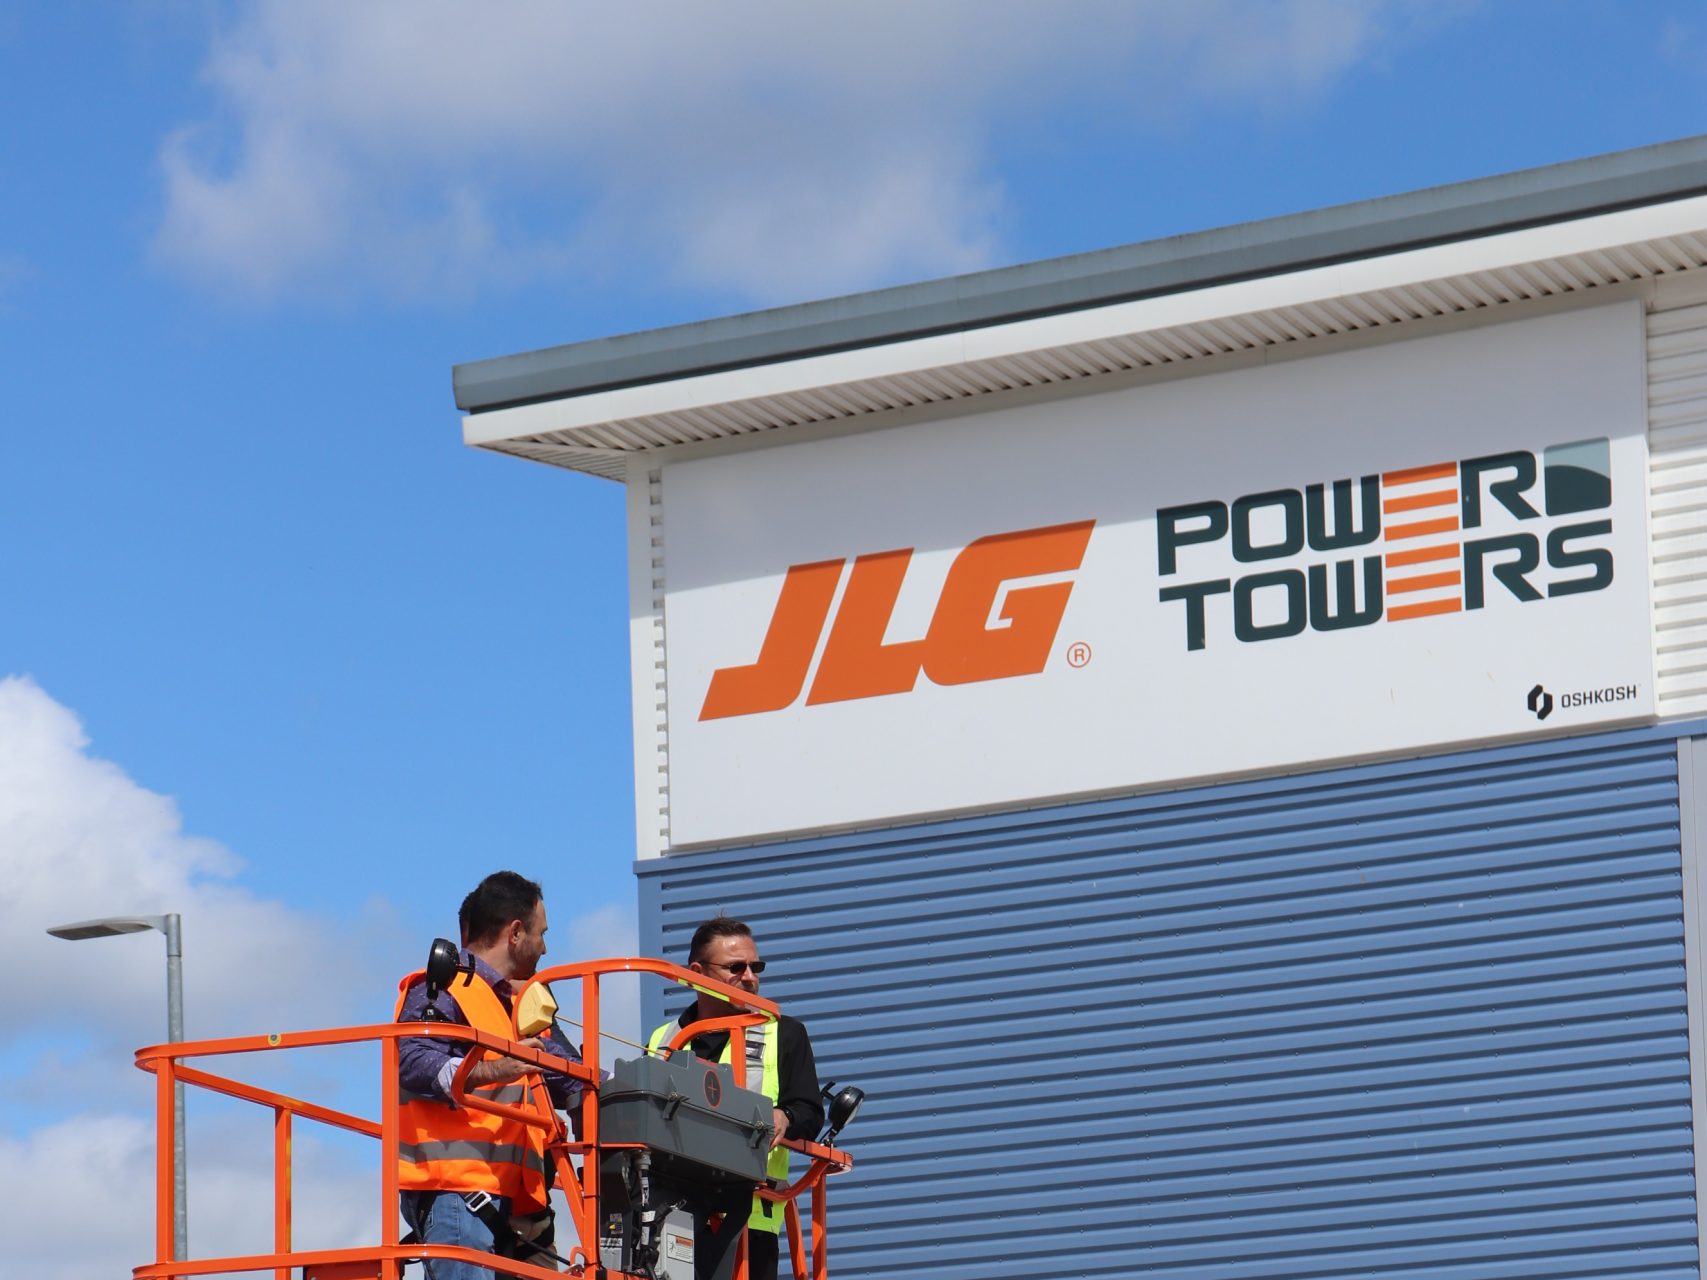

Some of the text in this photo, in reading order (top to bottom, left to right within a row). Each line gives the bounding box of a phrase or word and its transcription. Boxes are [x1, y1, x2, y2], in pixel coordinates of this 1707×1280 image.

[1156, 450, 1541, 576] POWER
[698, 519, 1096, 721] JLG
[1159, 519, 1614, 651] TOWERS
[1561, 684, 1637, 708] OSHKOSH
